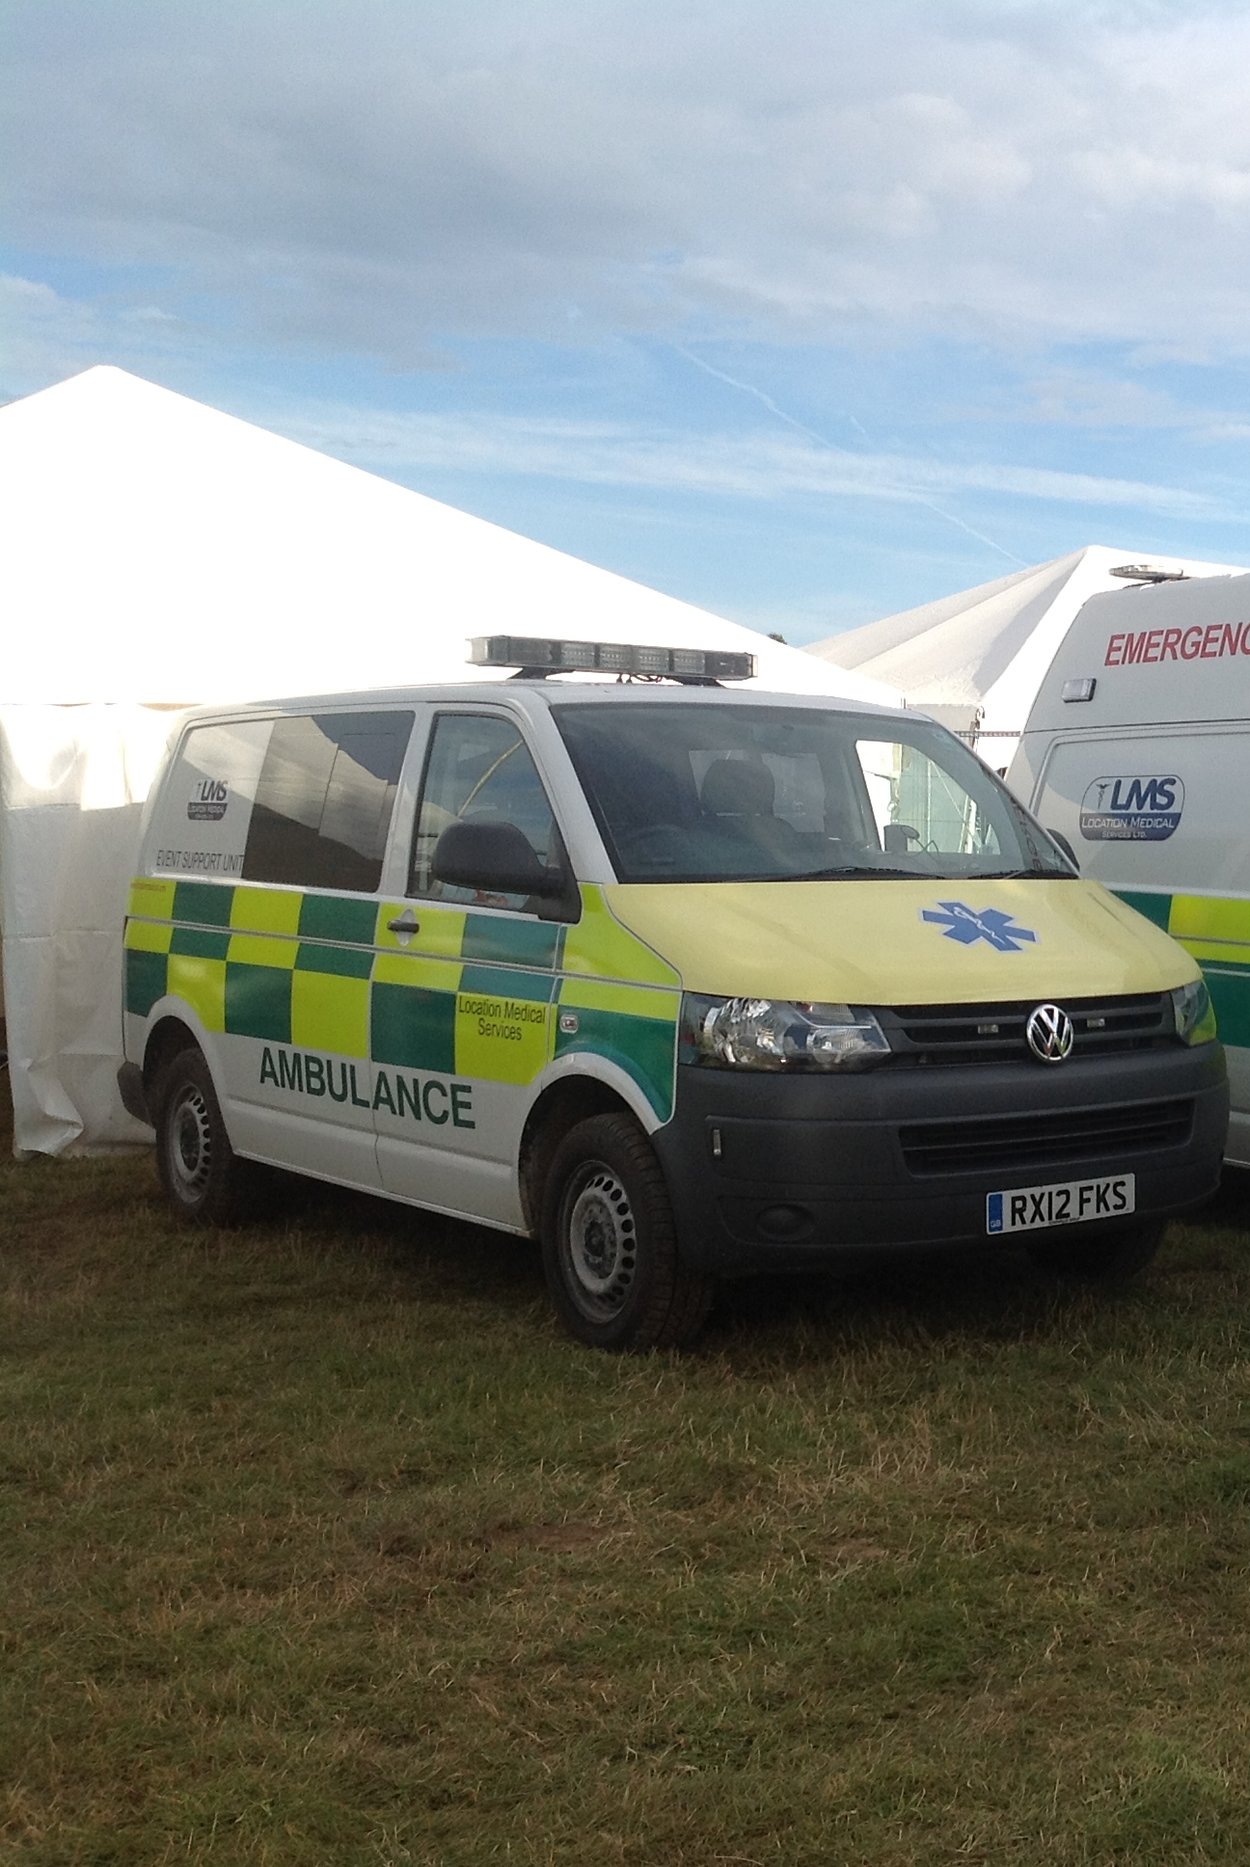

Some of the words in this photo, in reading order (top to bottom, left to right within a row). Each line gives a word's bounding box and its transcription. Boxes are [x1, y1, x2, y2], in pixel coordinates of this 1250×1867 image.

[200, 780, 228, 801] LMS
[1110, 778, 1177, 811] LMS
[156, 849, 182, 868] EVENT
[182, 851, 222, 869] SUPPORT
[222, 854, 245, 872] UNIT
[458, 995, 501, 1018] Location
[504, 1001, 546, 1025] Medical
[478, 1017, 523, 1041] Services
[259, 1046, 477, 1130] AMBULANCE
[1010, 1188, 1071, 1227] RX12
[1078, 1180, 1127, 1217] FKS
